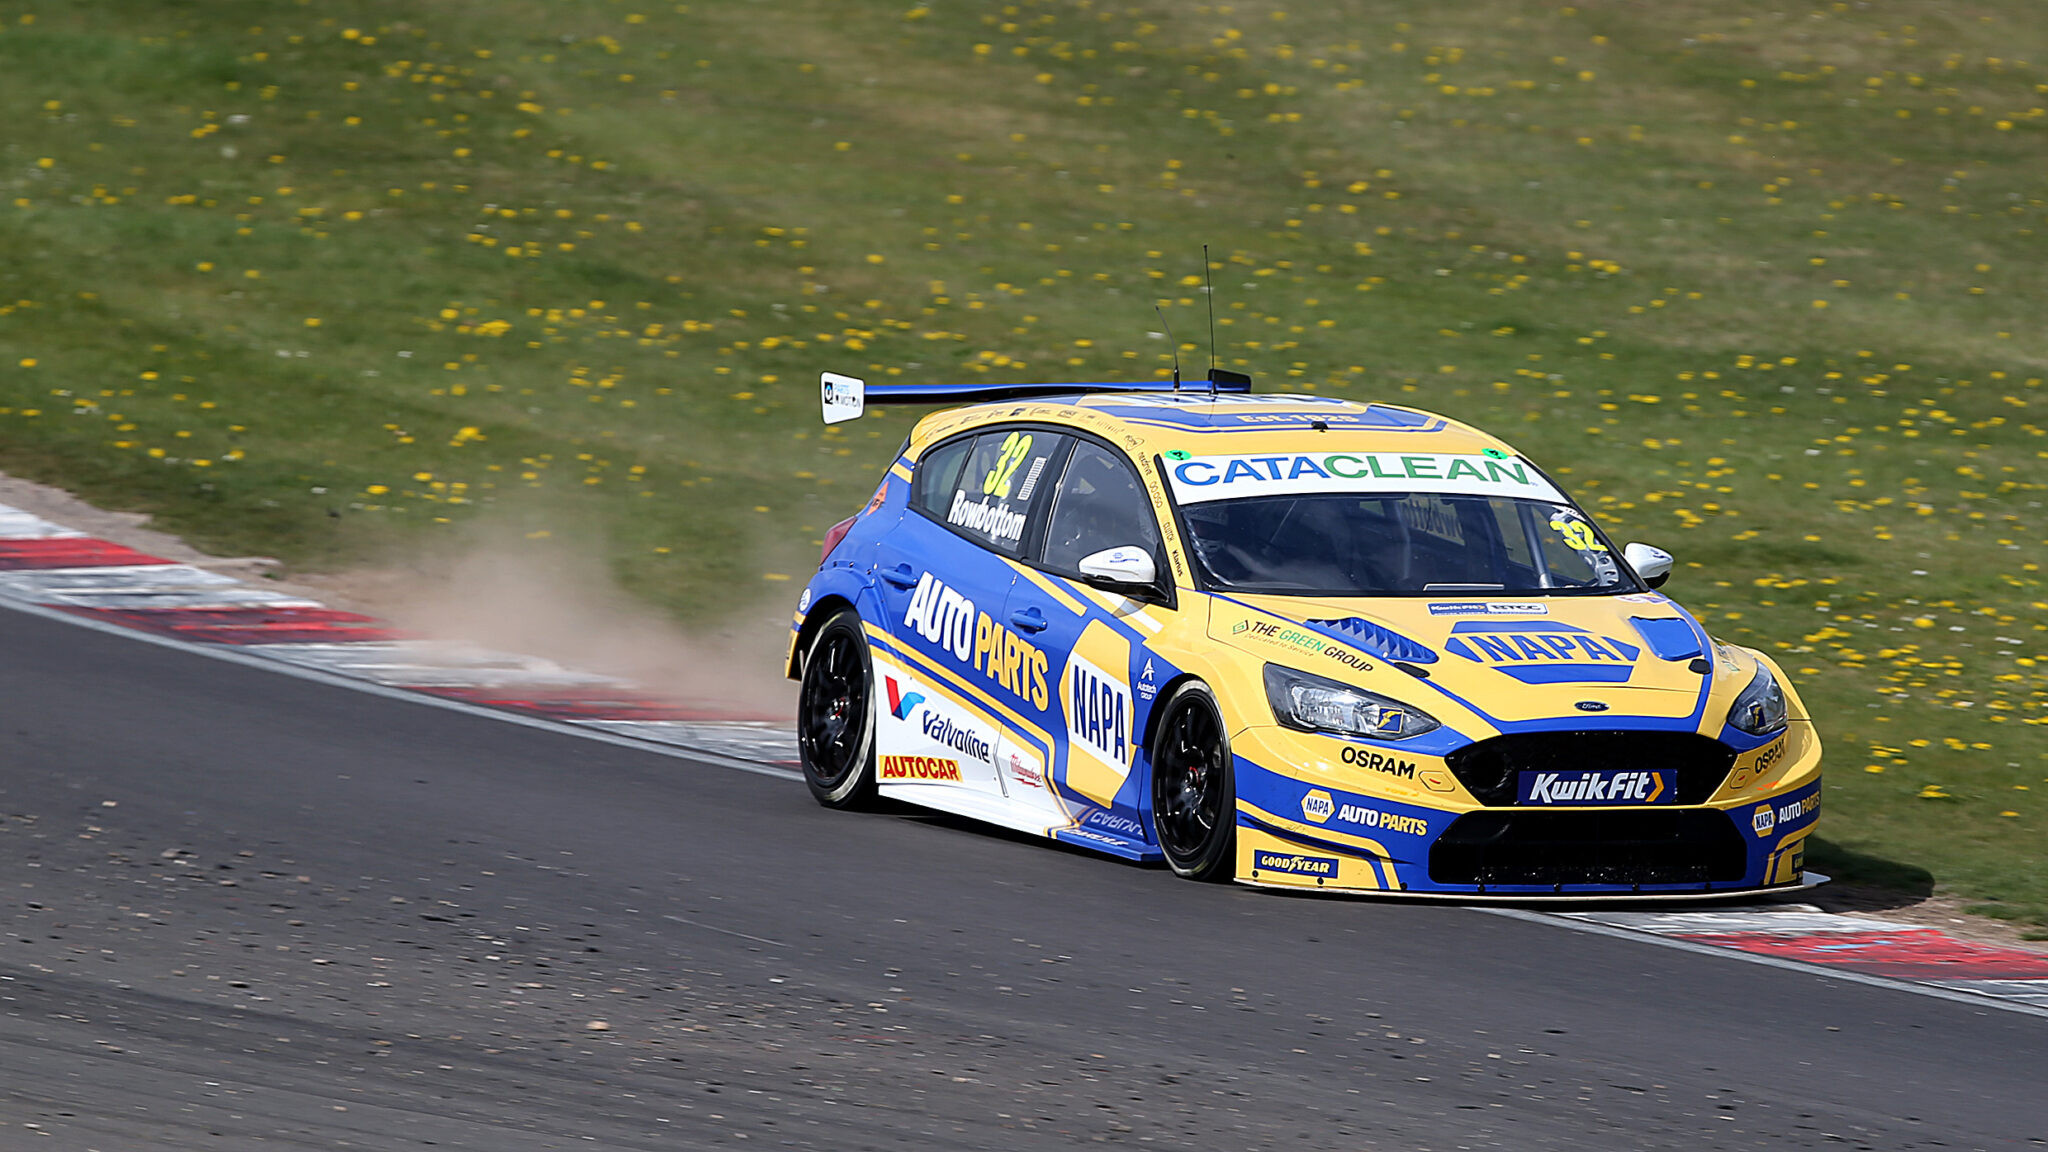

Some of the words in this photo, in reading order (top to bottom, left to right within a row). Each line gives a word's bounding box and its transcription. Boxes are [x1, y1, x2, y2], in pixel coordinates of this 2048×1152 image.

[983, 431, 1033, 498] 32
[947, 489, 1027, 541] Rowbottom
[1549, 520, 1609, 552] 32
[903, 570, 975, 663] AUTO
[974, 610, 1049, 712] PARTS
[1252, 621, 1281, 637] THE
[1279, 629, 1326, 652] GREEN
[1324, 646, 1374, 672] GROUP
[1467, 635, 1623, 662] NAPA
[1074, 664, 1126, 765] NAPA
[923, 709, 991, 764] Valvoline
[883, 756, 960, 781] AUTOCAR
[1341, 746, 1416, 780] OSRAM
[1305, 797, 1330, 816] NAPA
[1337, 804, 1379, 827] AUTO
[1378, 812, 1428, 837] PARTS
[1755, 810, 1774, 830] NAPA
[1778, 801, 1801, 824] AUTO
[1261, 855, 1331, 874] GOODYEAR
